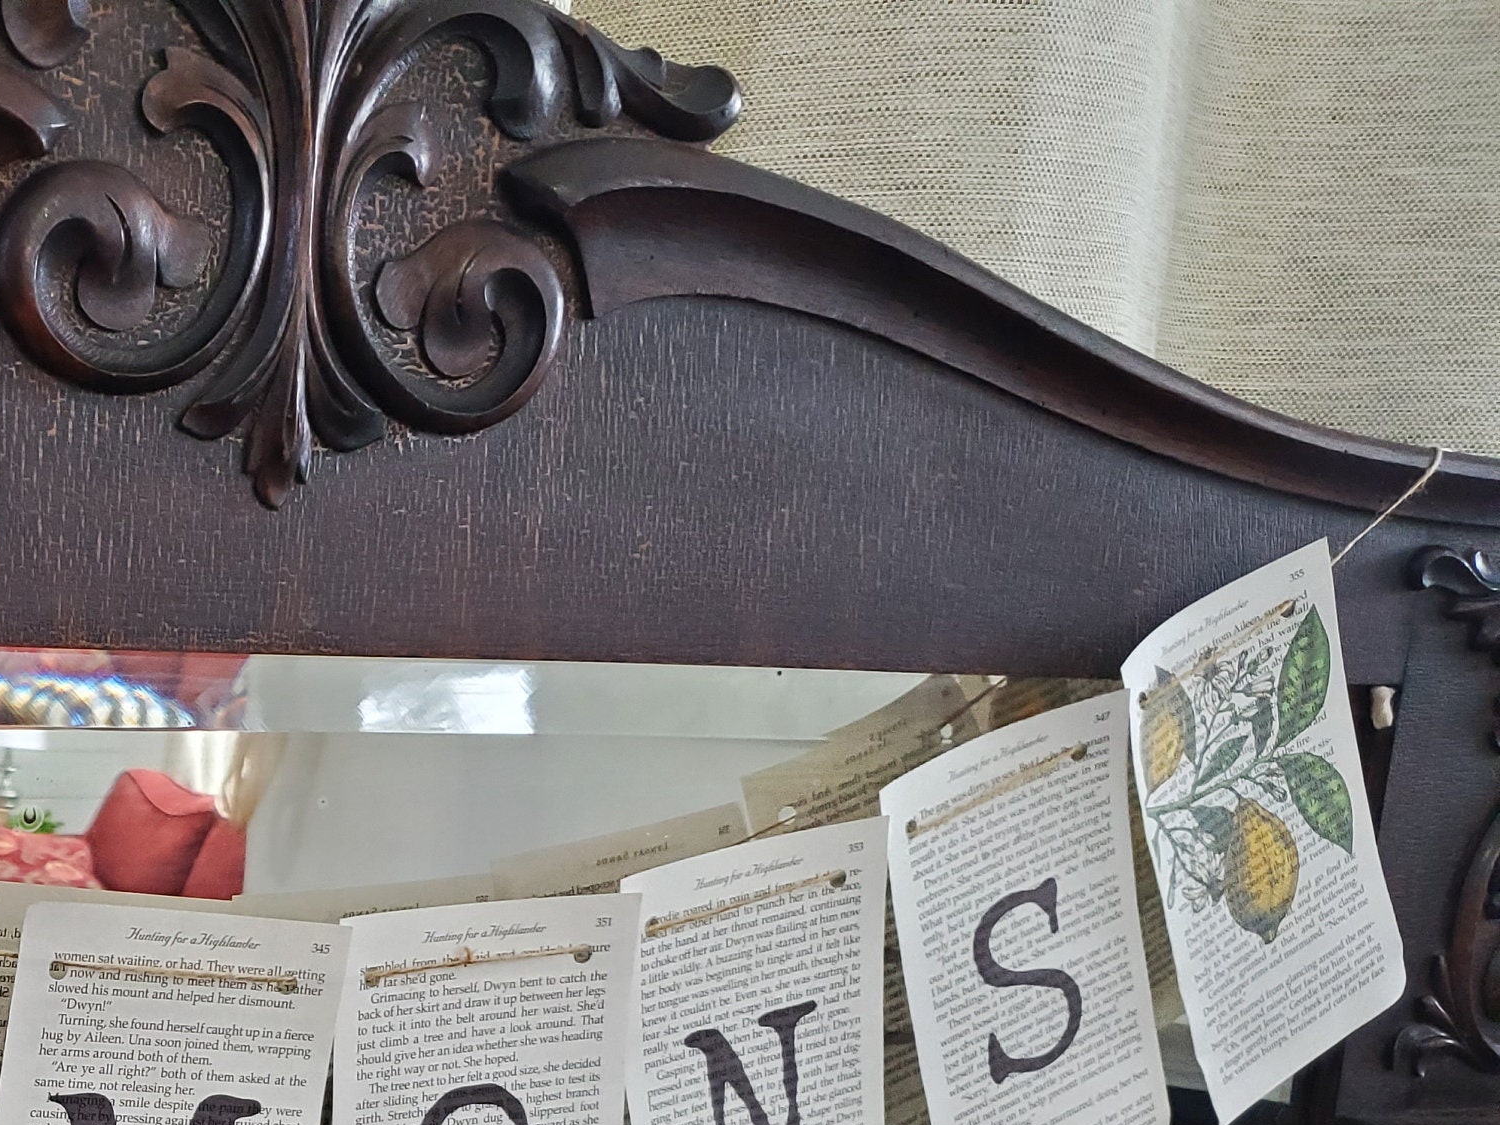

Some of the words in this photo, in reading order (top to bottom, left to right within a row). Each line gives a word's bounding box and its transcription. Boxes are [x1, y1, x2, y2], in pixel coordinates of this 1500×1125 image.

[1289, 568, 1305, 581] 355
[910, 847, 937, 869] mouth
[937, 844, 947, 855] to
[947, 838, 959, 849] do
[960, 833, 969, 843] it,
[969, 825, 985, 839] but
[985, 814, 1008, 830] there
[1009, 808, 1027, 819] was
[1027, 790, 1063, 811] nothing
[1064, 772, 1111, 795] lascivious
[847, 841, 864, 854] 353
[694, 875, 730, 891] Hunting
[728, 869, 744, 885] for
[744, 870, 751, 878] a
[748, 855, 804, 878] Highlander
[422, 930, 465, 945] Hunting
[463, 927, 480, 942] for
[480, 930, 488, 938] a
[486, 922, 547, 941] Highlander
[595, 916, 612, 928] 351
[125, 927, 172, 947] Hunting
[170, 930, 189, 947] for
[189, 937, 197, 945] a
[195, 932, 261, 951] Highlander
[311, 942, 331, 955] 345
[47, 980, 89, 995] slowed
[91, 982, 109, 996] his
[111, 988, 149, 999] mount
[151, 988, 174, 1001] and
[176, 988, 215, 1006] helped
[217, 991, 237, 1005] her
[238, 994, 295, 1010] dismount.
[974, 879, 1081, 1083] S
[357, 1007, 382, 1022] back
[383, 1005, 395, 1018] of
[396, 1004, 414, 1017] her
[415, 1001, 440, 1014] skirt
[441, 998, 462, 1011] and
[463, 996, 491, 1009] draw
[493, 994, 501, 1006] it
[503, 995, 518, 1008] up
[519, 991, 563, 1003] between
[565, 986, 584, 999] her
[585, 985, 607, 999] legs
[1222, 1072, 1234, 1086] the
[1234, 1053, 1261, 1075] various
[1260, 1035, 1290, 1057] bumps,
[1289, 1014, 1318, 1037] bruises
[1318, 1001, 1332, 1018] and
[1332, 993, 1348, 1008] cuts
[1347, 984, 1358, 997] on
[1357, 975, 1370, 990] her
[1370, 966, 1385, 981] face
[40, 1027, 64, 1045] hug
[66, 1028, 82, 1046] by
[84, 1031, 125, 1045] Aileen.
[128, 1033, 152, 1046] Una
[154, 1038, 182, 1049] soon
[183, 1037, 220, 1052] joined
[222, 1039, 254, 1054] them,
[257, 1045, 312, 1061] wrapping
